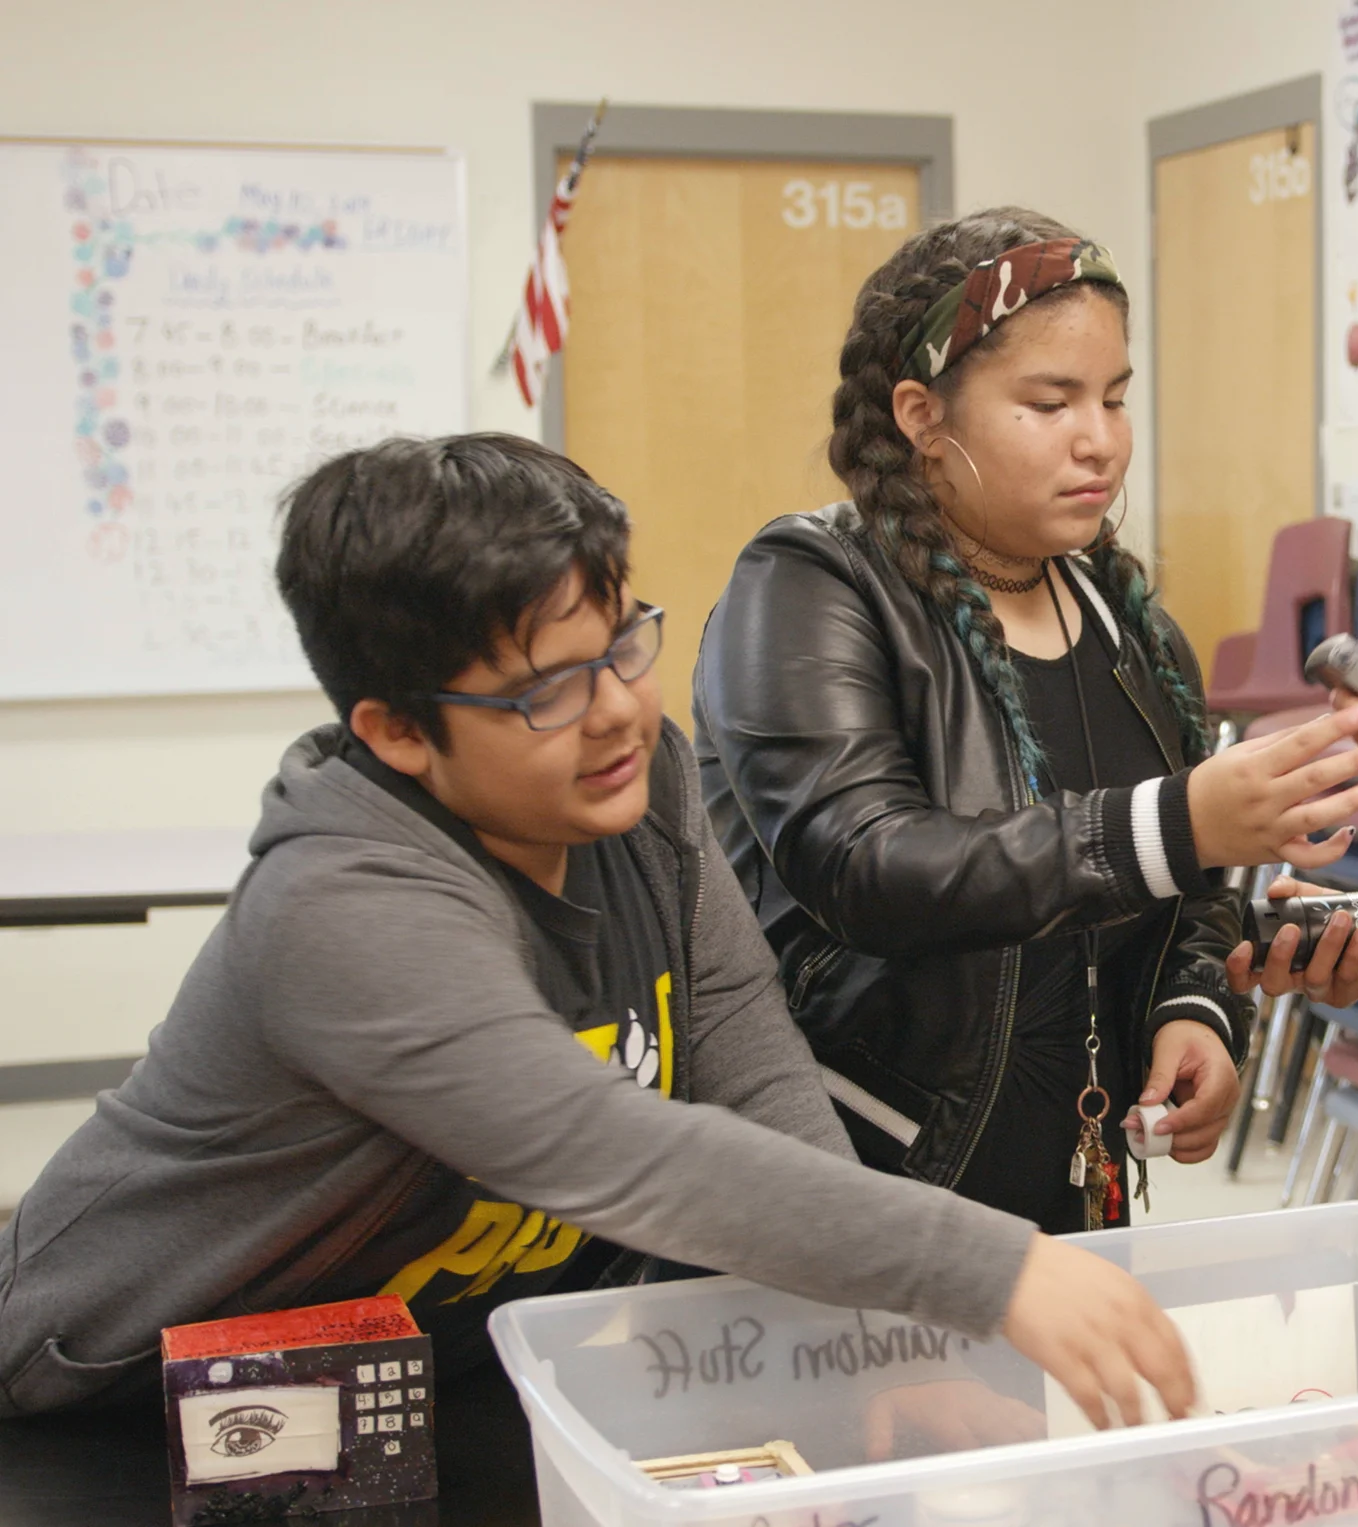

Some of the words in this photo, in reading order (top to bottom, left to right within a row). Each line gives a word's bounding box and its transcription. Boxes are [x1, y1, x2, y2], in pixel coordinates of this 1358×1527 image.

[107, 156, 203, 215] Date
[781, 178, 907, 230] 315a
[387, 1366, 397, 1377] 2
[411, 1361, 420, 1372] 3
[358, 1395, 367, 1406] 4
[384, 1392, 394, 1404] 5
[412, 1387, 422, 1399] 6
[360, 1418, 368, 1430] 7
[385, 1415, 396, 1428] 8
[387, 1441, 397, 1452] 0
